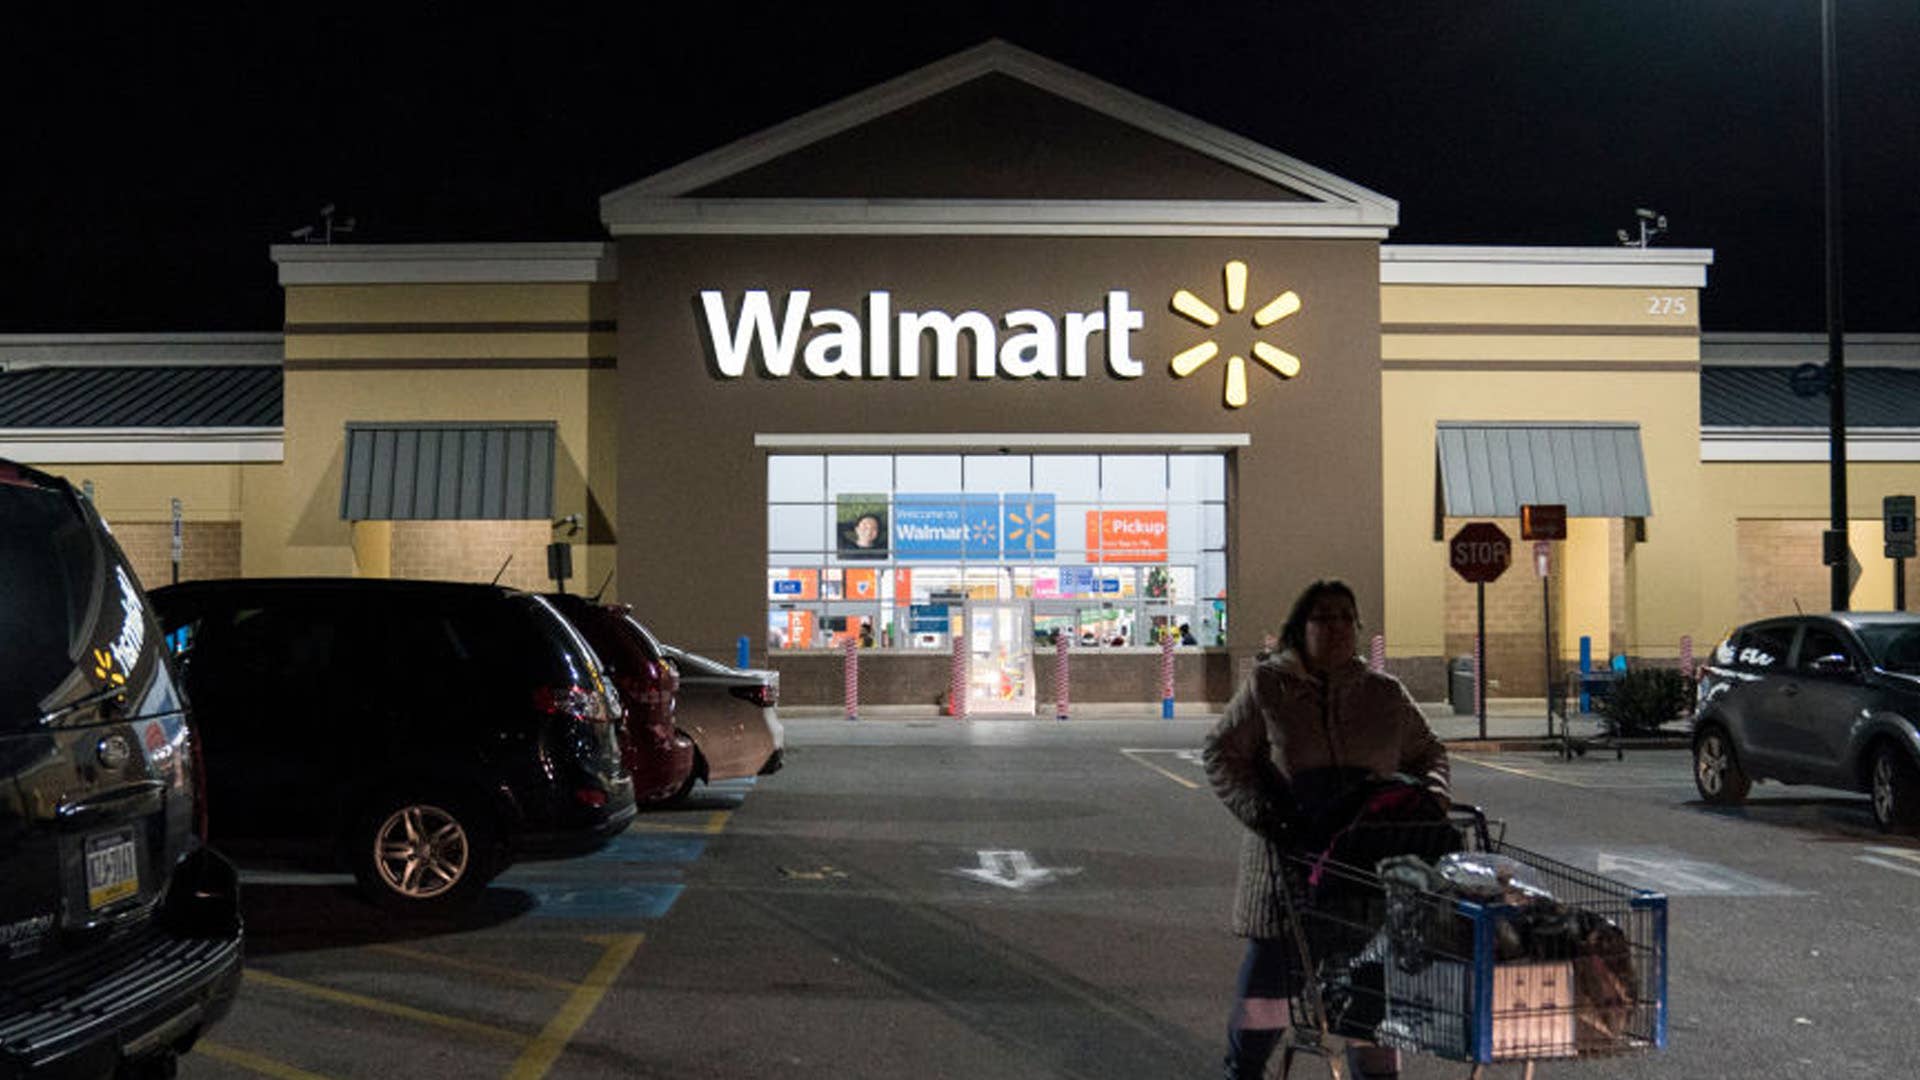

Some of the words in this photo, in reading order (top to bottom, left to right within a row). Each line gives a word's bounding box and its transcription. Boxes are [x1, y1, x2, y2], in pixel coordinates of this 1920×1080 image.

[1649, 296, 1686, 315] 275
[701, 290, 1144, 376] Walmart
[897, 523, 971, 542] Walmart
[1112, 518, 1165, 537] Pickup
[1455, 542, 1507, 566] STOP
